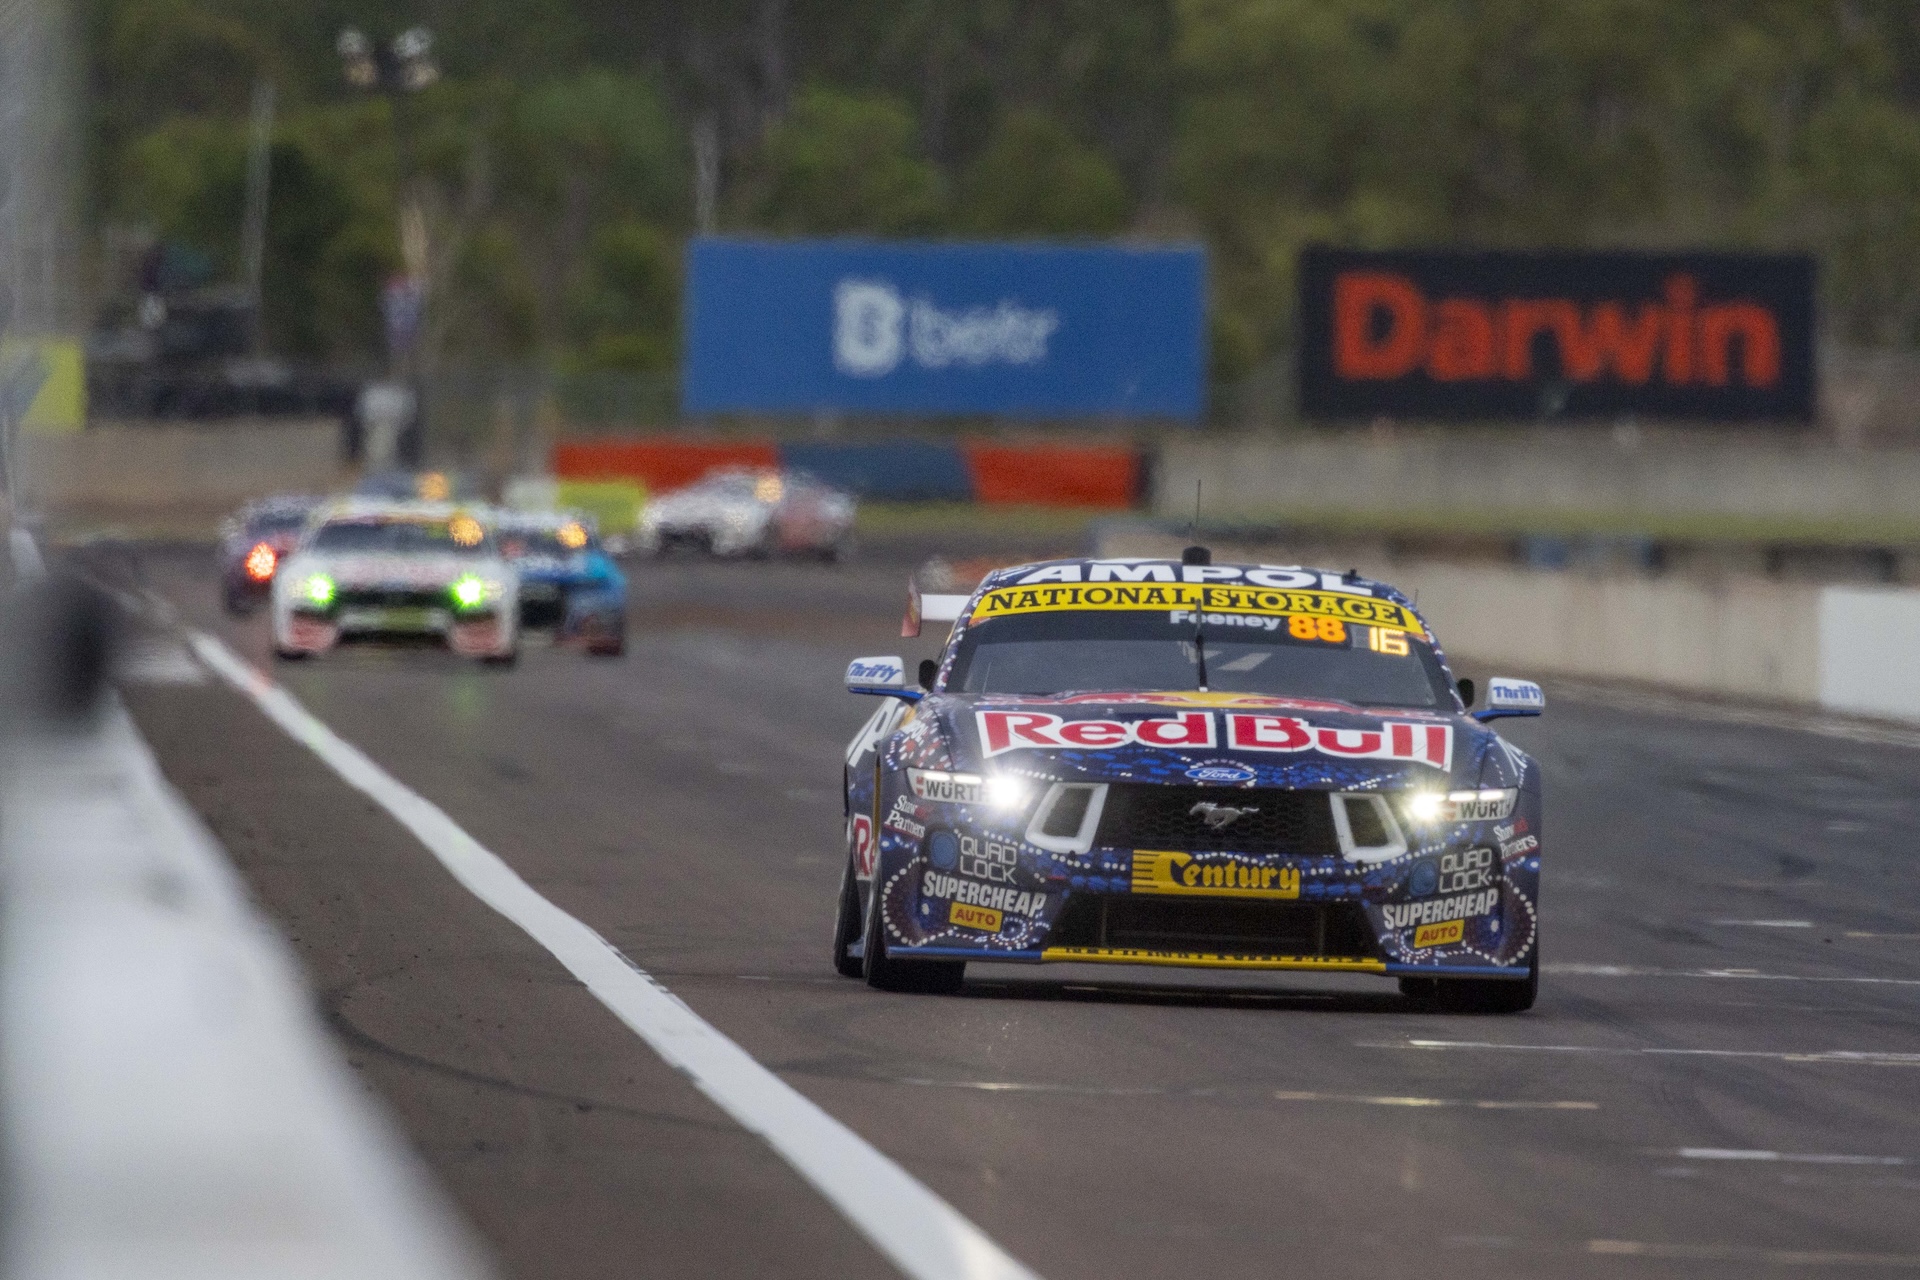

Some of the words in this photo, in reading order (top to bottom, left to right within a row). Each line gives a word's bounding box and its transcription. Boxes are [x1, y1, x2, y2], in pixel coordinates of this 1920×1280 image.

[1333, 271, 1781, 388] Darwin
[1017, 564, 1372, 595] AMPOL
[987, 587, 1195, 612] NATIONAL
[1211, 590, 1400, 625] STORAGE
[1170, 610, 1281, 631] Feeney
[1288, 615, 1346, 643] 88
[1369, 627, 1409, 656] 16
[978, 711, 1215, 757] Red
[1229, 714, 1453, 770] Bull
[1197, 768, 1241, 781] Ford
[960, 836, 1017, 865] QUAD
[1440, 848, 1493, 874] QUAD
[959, 855, 1016, 884] LOCK
[1143, 850, 1300, 896] Century
[1439, 867, 1490, 893] LOCK
[922, 870, 1047, 918] SUPERCHEAP
[1383, 888, 1499, 930] SUPERCHEAP
[955, 908, 996, 926] AUTO
[1420, 925, 1459, 941] AUTO
